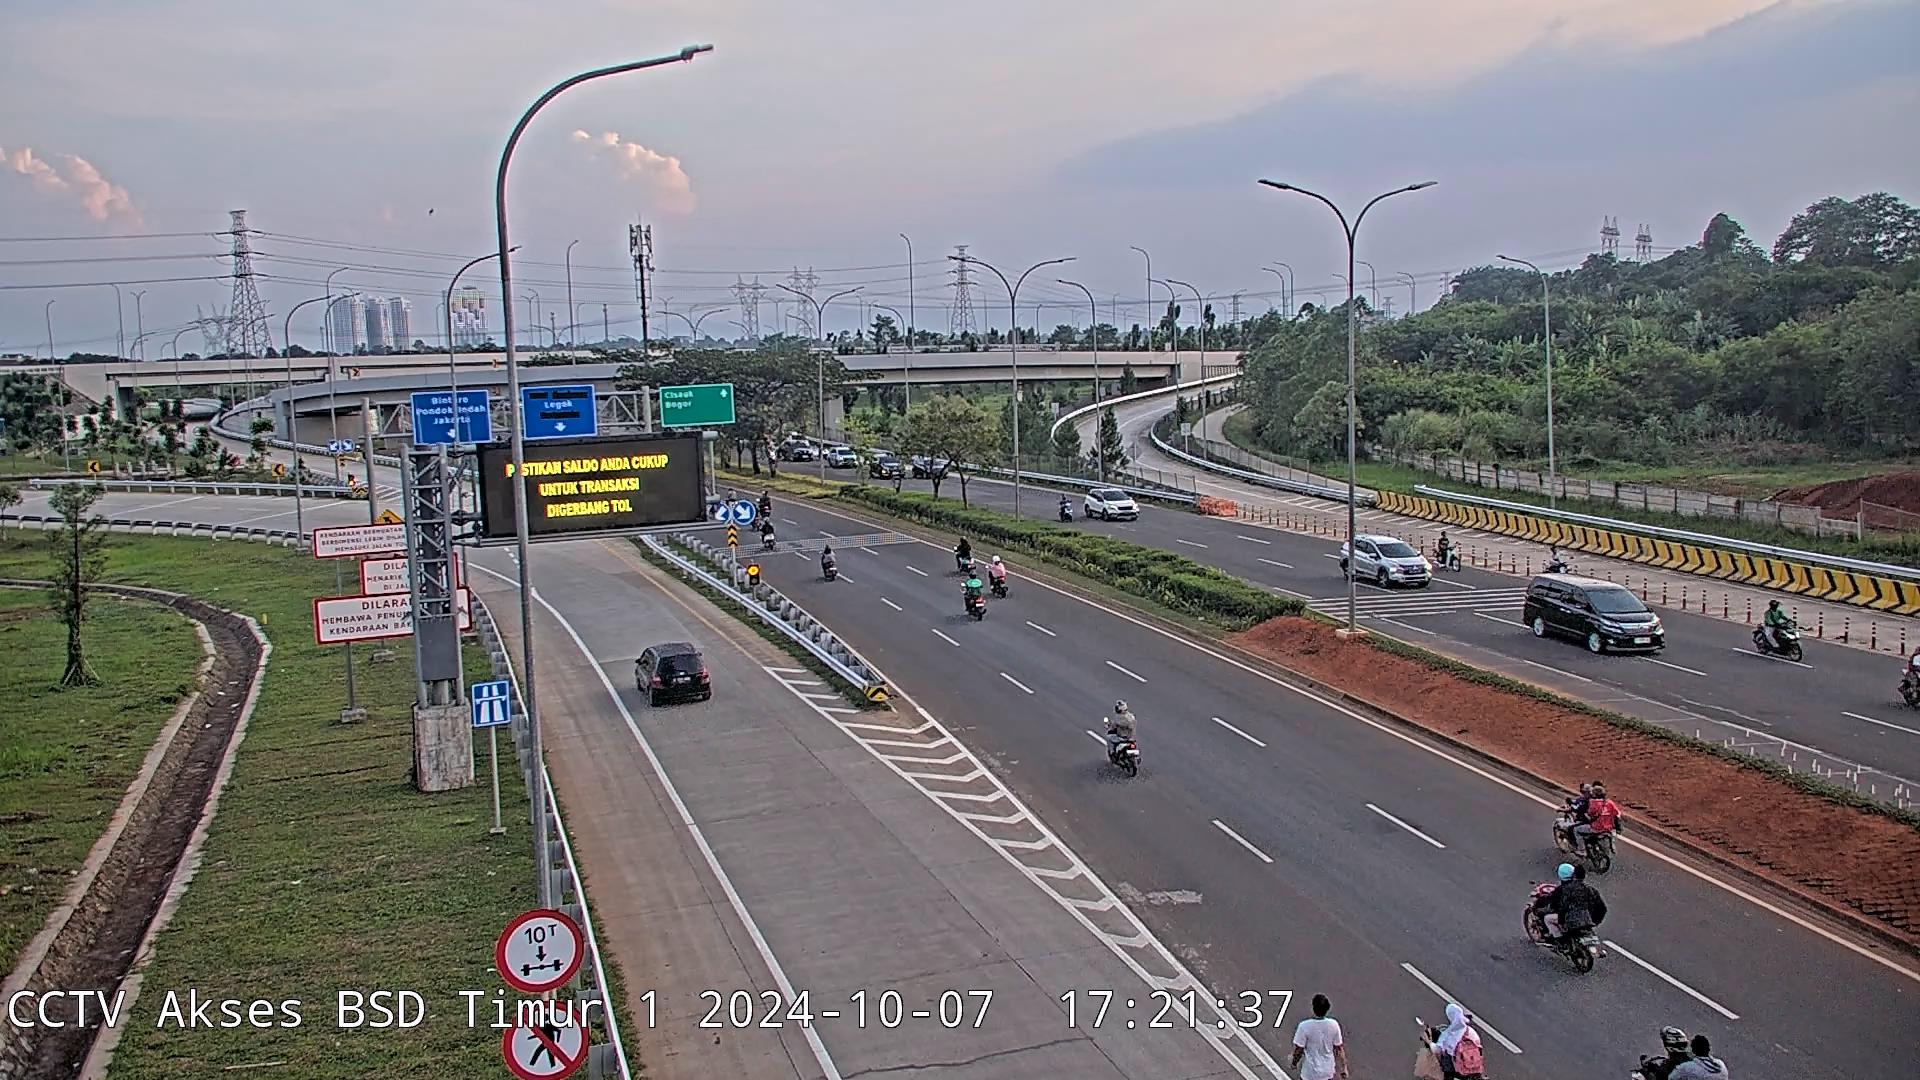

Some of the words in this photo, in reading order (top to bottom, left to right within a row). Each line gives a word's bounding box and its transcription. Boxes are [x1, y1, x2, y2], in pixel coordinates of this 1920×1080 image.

[431, 396, 469, 404] Bintro
[665, 401, 692, 410] Bogor
[504, 461, 562, 478] PSTIKAN
[562, 458, 598, 474] SALDO
[600, 456, 630, 472] ANDA
[631, 454, 668, 469] CUKUP
[538, 480, 579, 496] UNTUK
[580, 478, 640, 494] TRANSAKSI
[546, 502, 610, 518] DIGERBANG
[610, 499, 633, 513] TOL
[322, 614, 372, 624] MEMBAWA
[330, 624, 388, 635] KENDARAAN
